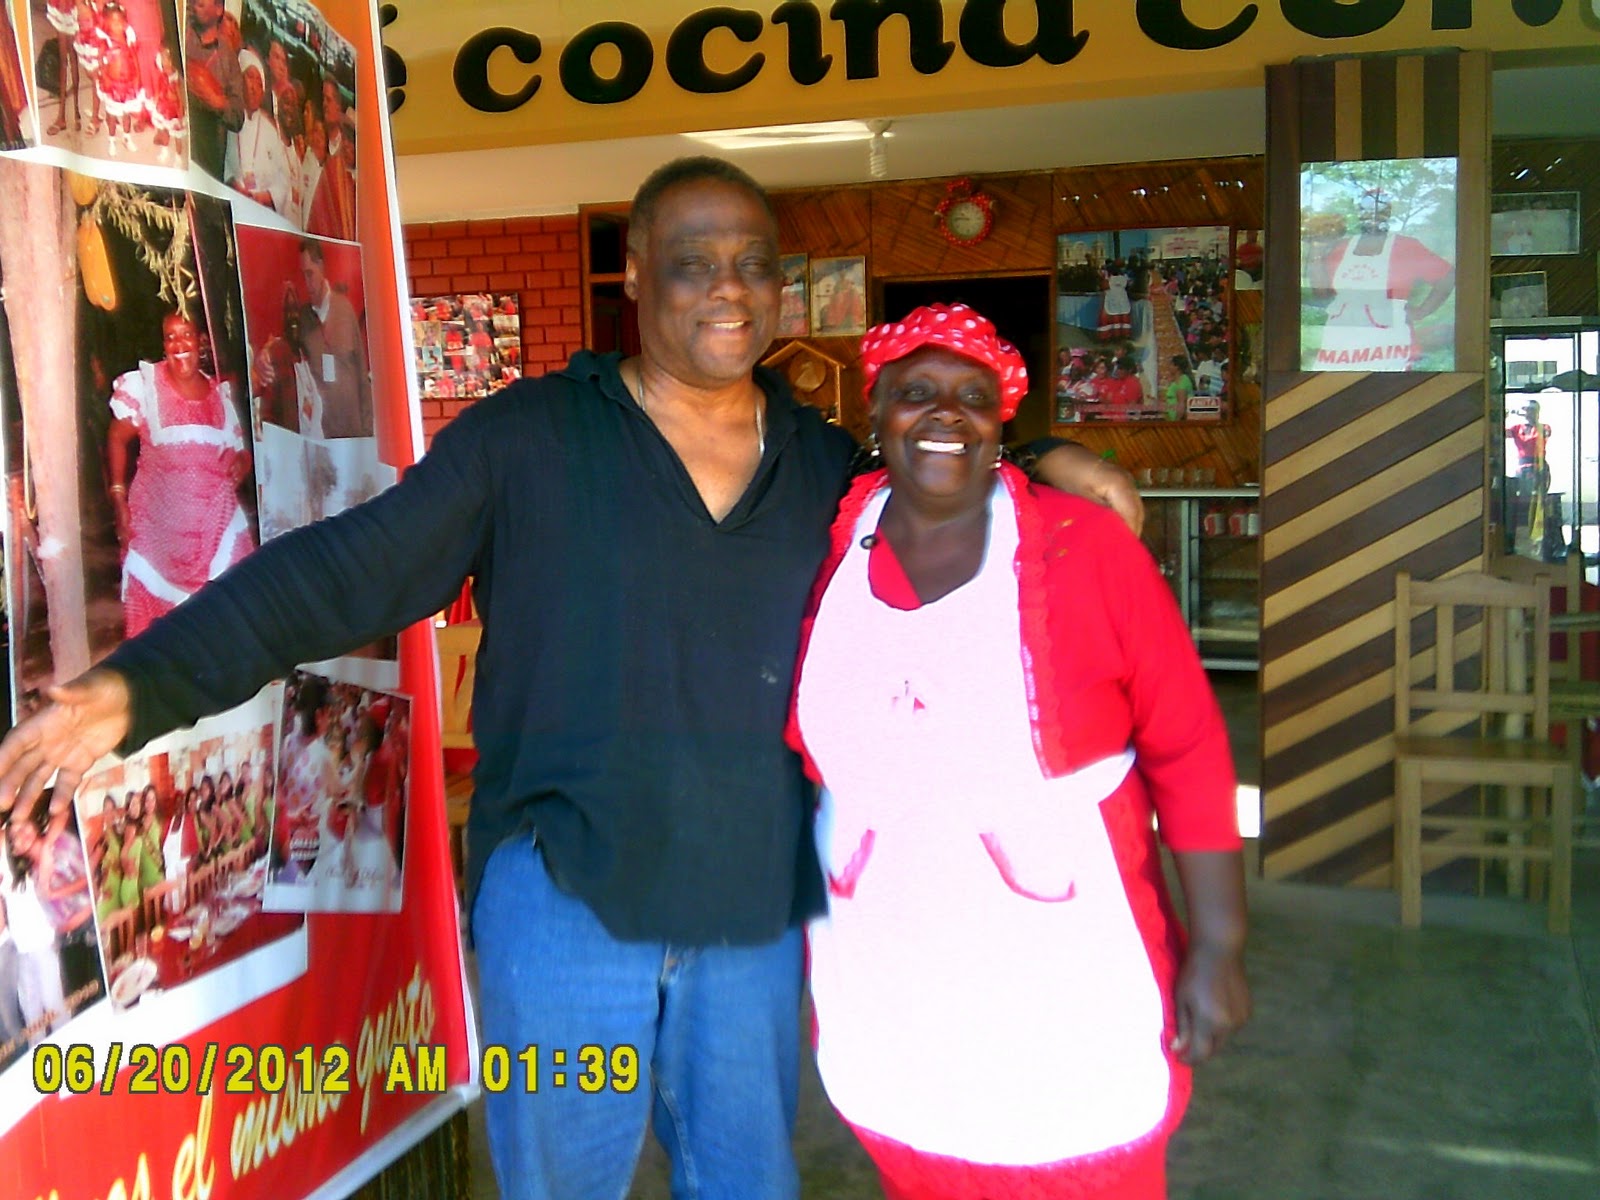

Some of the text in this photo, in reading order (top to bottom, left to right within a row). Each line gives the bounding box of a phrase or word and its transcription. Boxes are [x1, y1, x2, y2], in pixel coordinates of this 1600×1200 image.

[453, 0, 1090, 113] cocina
[172, 1078, 216, 1200] el
[356, 961, 435, 1136] gusto
